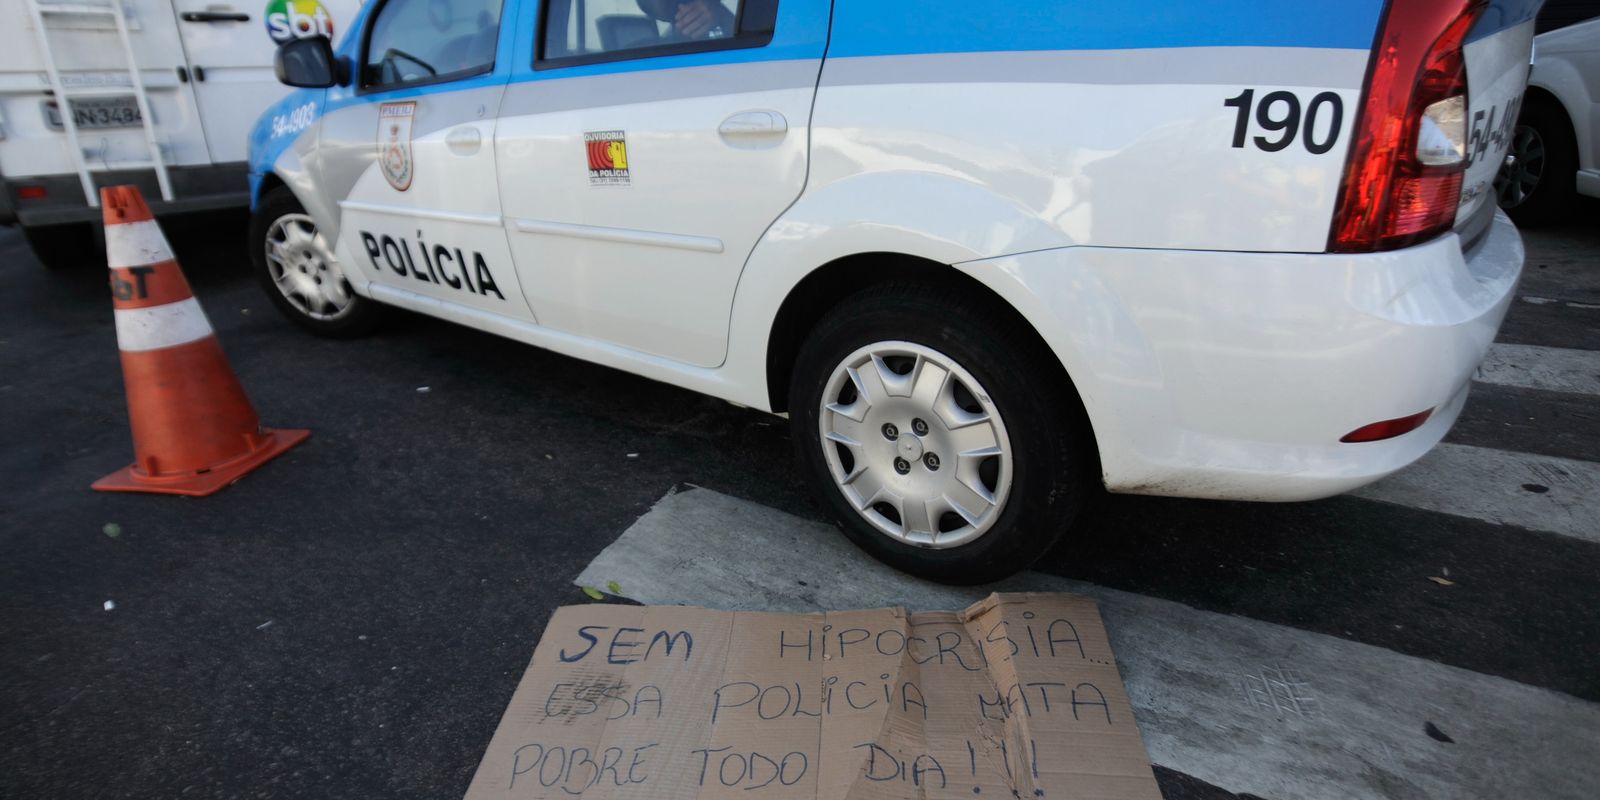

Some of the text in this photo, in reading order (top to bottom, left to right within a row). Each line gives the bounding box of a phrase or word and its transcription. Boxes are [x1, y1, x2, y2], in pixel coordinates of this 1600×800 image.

[269, 0, 330, 40] sbt
[585, 131, 624, 140] OUVIDORIA
[1224, 89, 1343, 154] 190
[590, 170, 599, 178] DA
[360, 230, 505, 300] POLÍCIA
[560, 625, 694, 664] SEM
[545, 682, 663, 720] ESSA
[509, 743, 660, 795] POBRE
[692, 746, 808, 790] TODO
